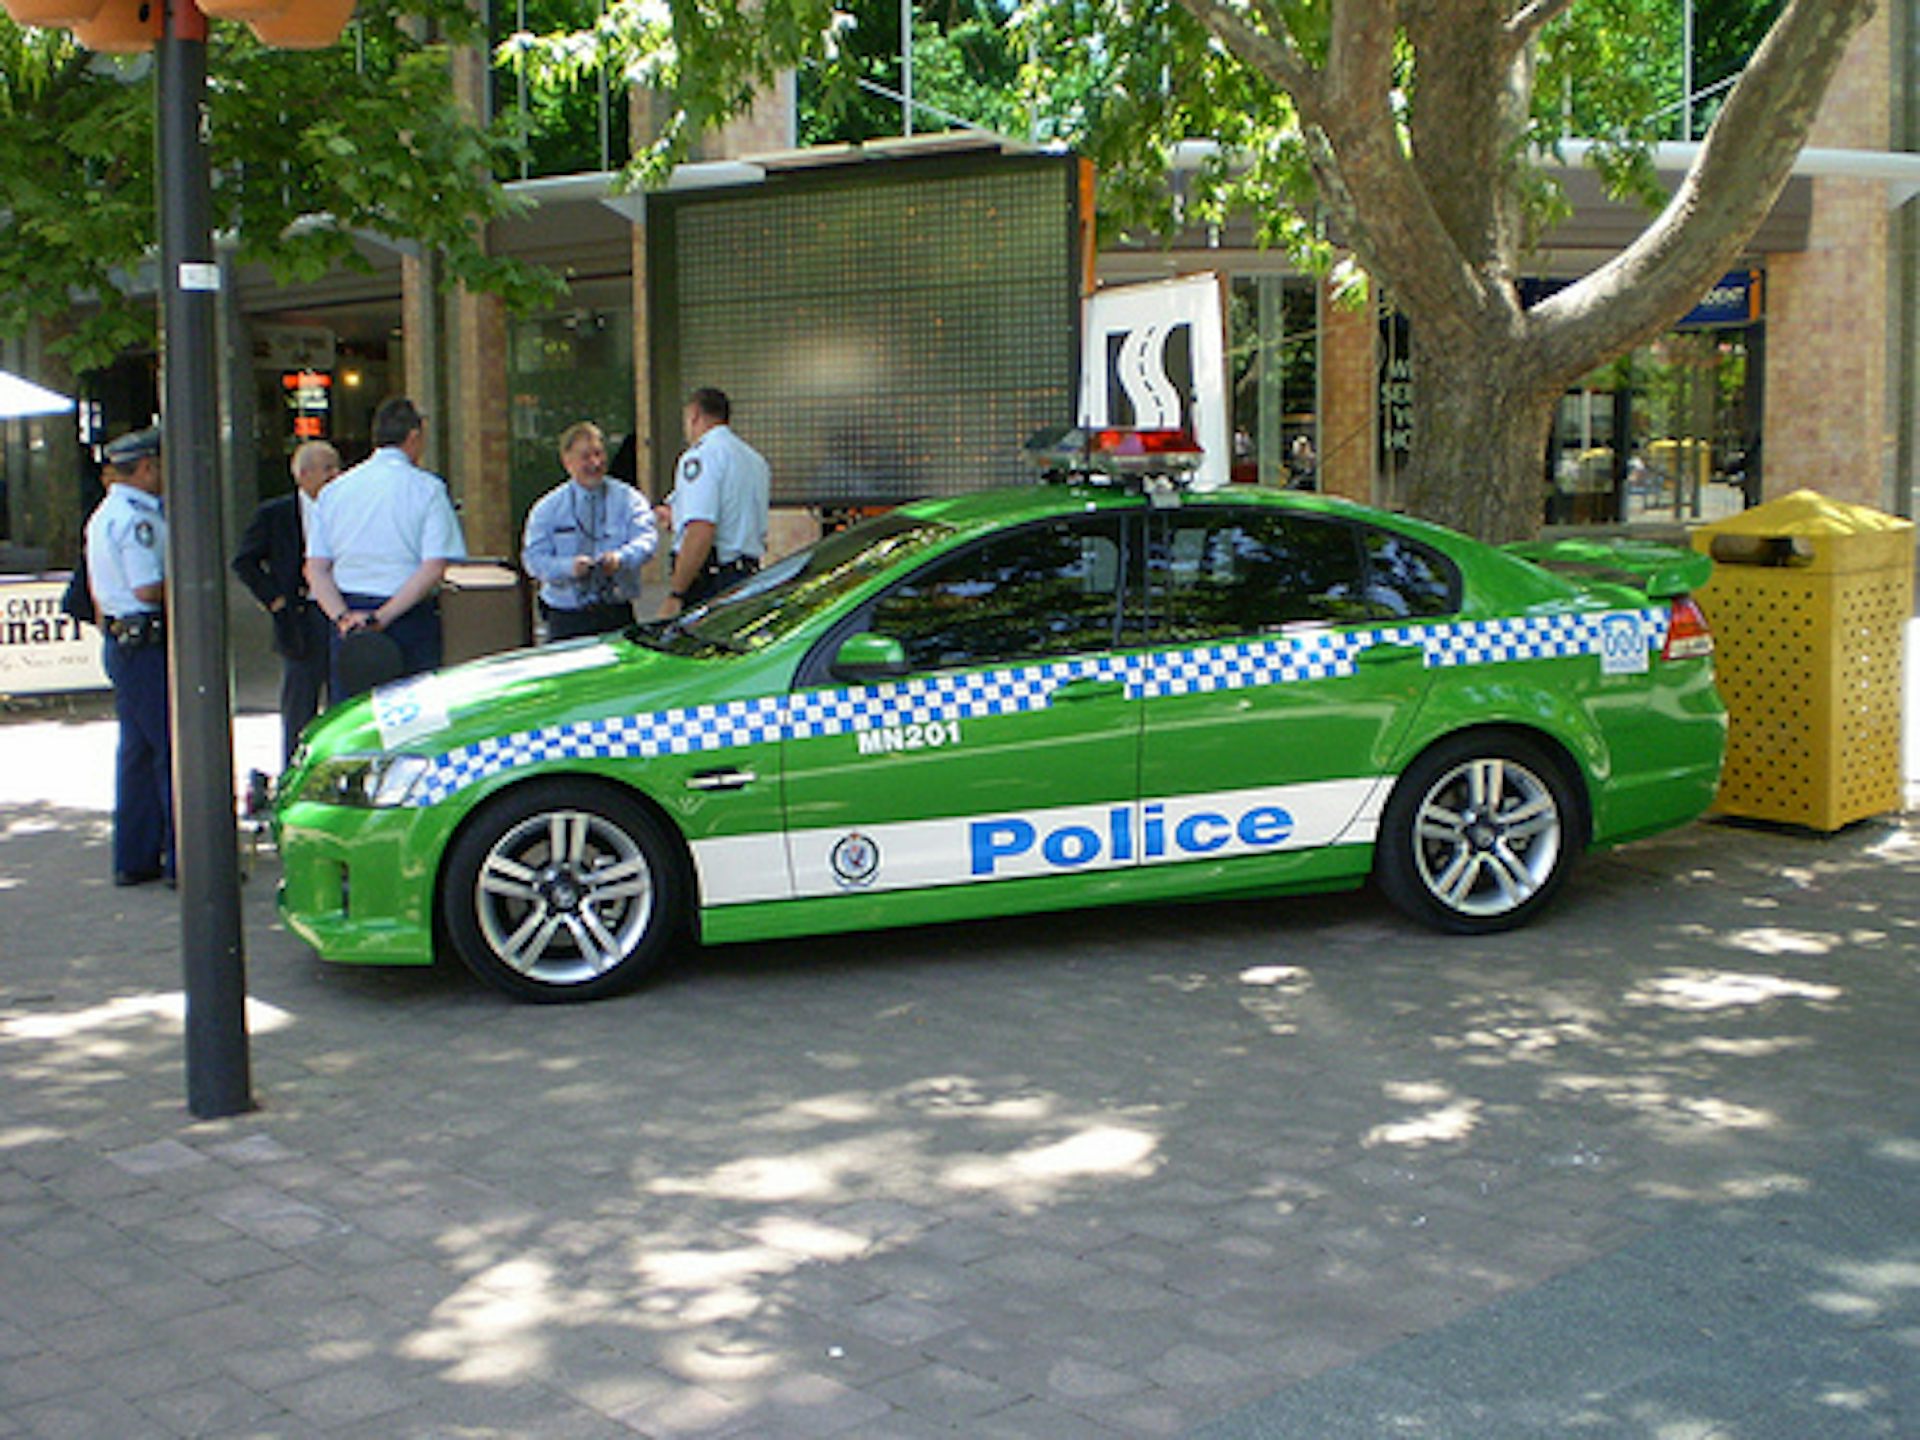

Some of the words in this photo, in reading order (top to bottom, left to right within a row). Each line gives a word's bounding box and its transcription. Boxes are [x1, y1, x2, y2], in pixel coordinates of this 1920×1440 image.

[7, 598, 59, 618] CAFF
[858, 720, 961, 754] MN201
[970, 803, 1295, 875] Police
